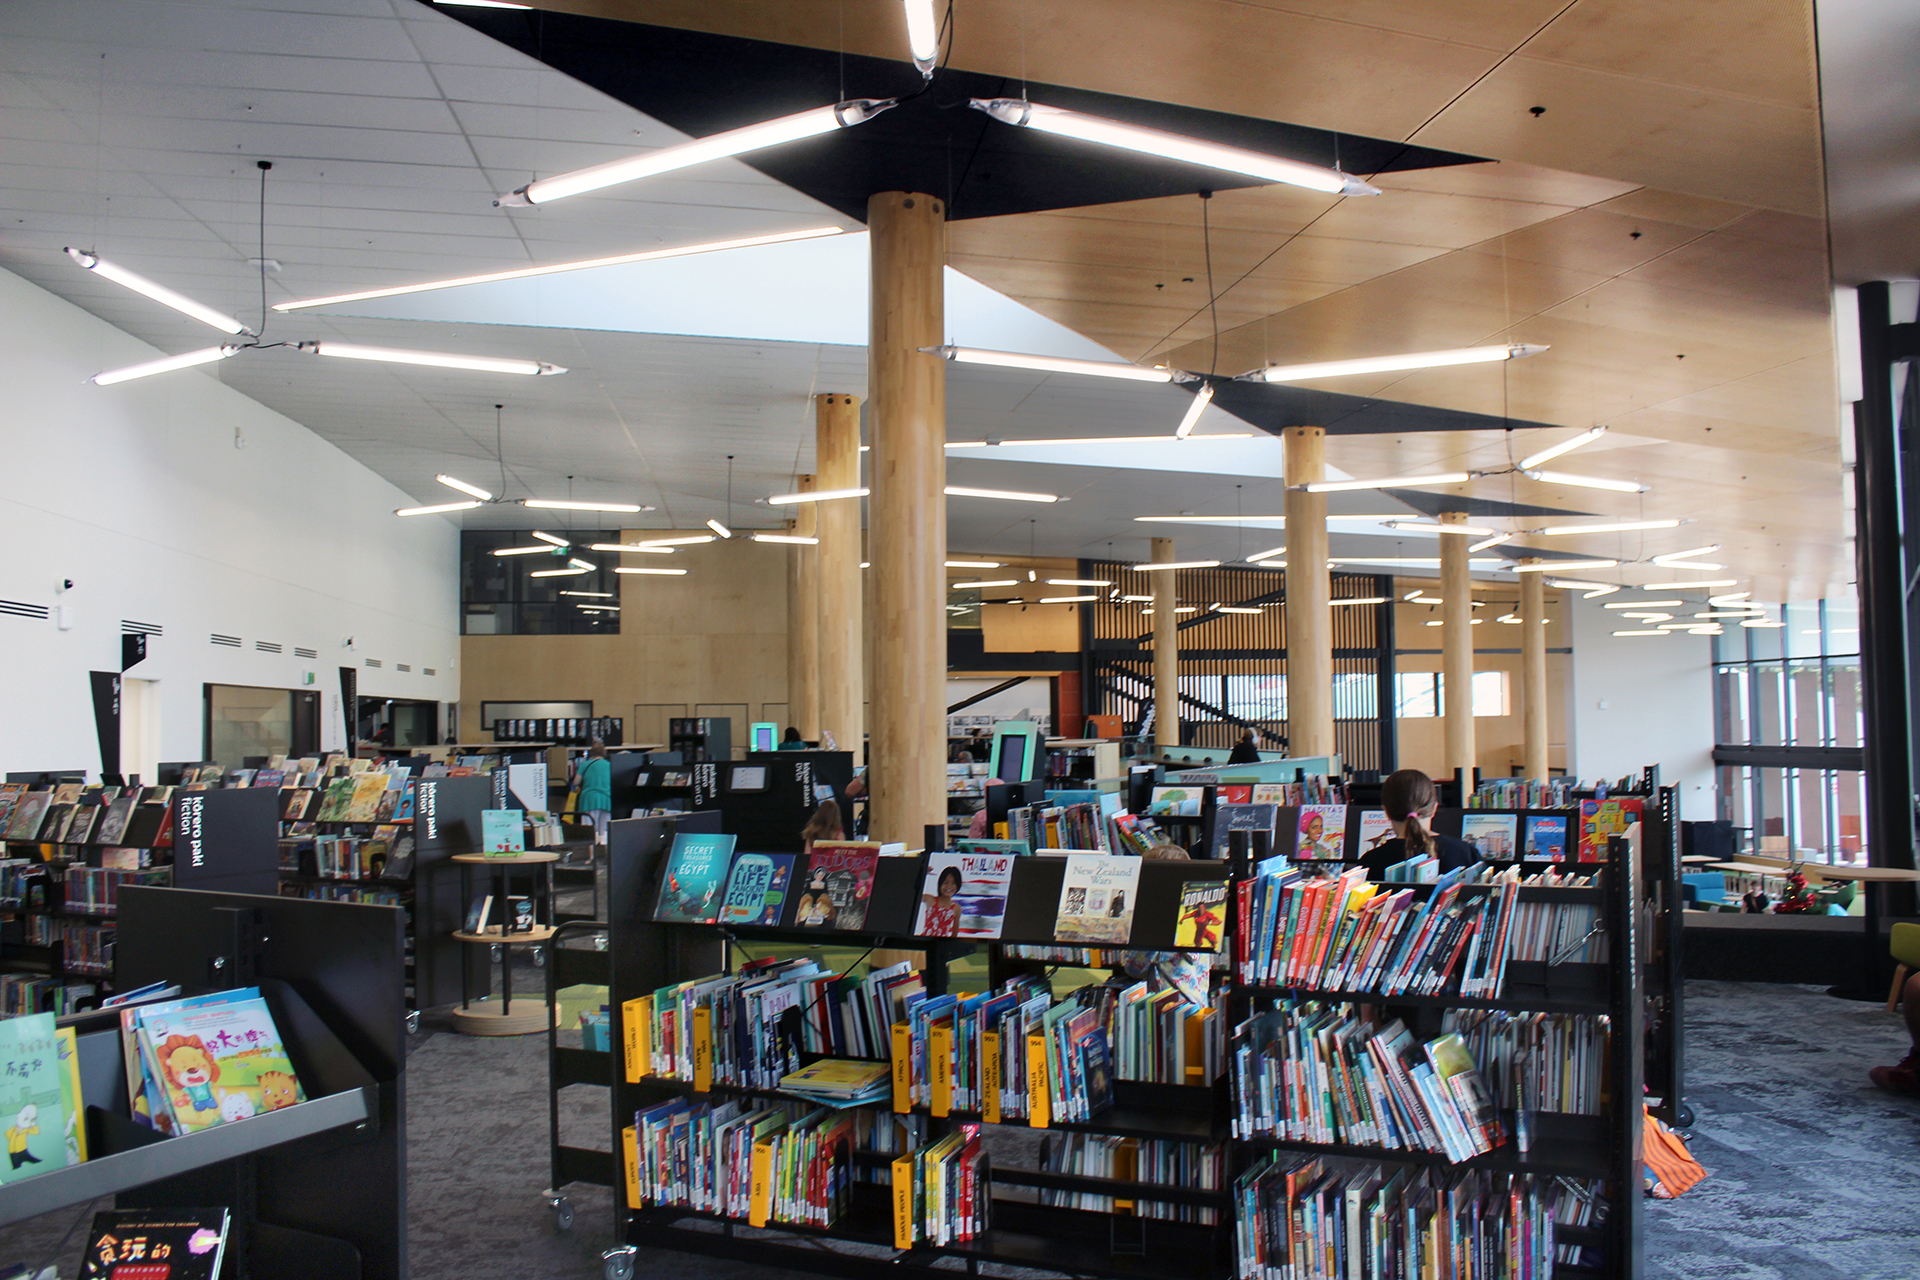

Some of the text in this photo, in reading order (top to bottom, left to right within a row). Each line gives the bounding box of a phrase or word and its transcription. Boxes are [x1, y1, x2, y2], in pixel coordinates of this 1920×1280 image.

[709, 764, 717, 798] pukapuka
[420, 782, 428, 814] fiction
[695, 794, 702, 805] CD
[181, 797, 192, 835] fiction
[190, 840, 204, 867] paki
[683, 846, 714, 856] SECRET
[816, 854, 872, 870] TUDORS
[962, 858, 1008, 871] THAILAND
[1097, 860, 1110, 868] The
[678, 864, 710, 875] EGYPT
[1072, 866, 1132, 877] New Zealand
[734, 872, 768, 885] LIFE
[1090, 876, 1112, 885] Wars
[729, 892, 764, 907] EGYPT
[1184, 887, 1226, 906] RONALDO
